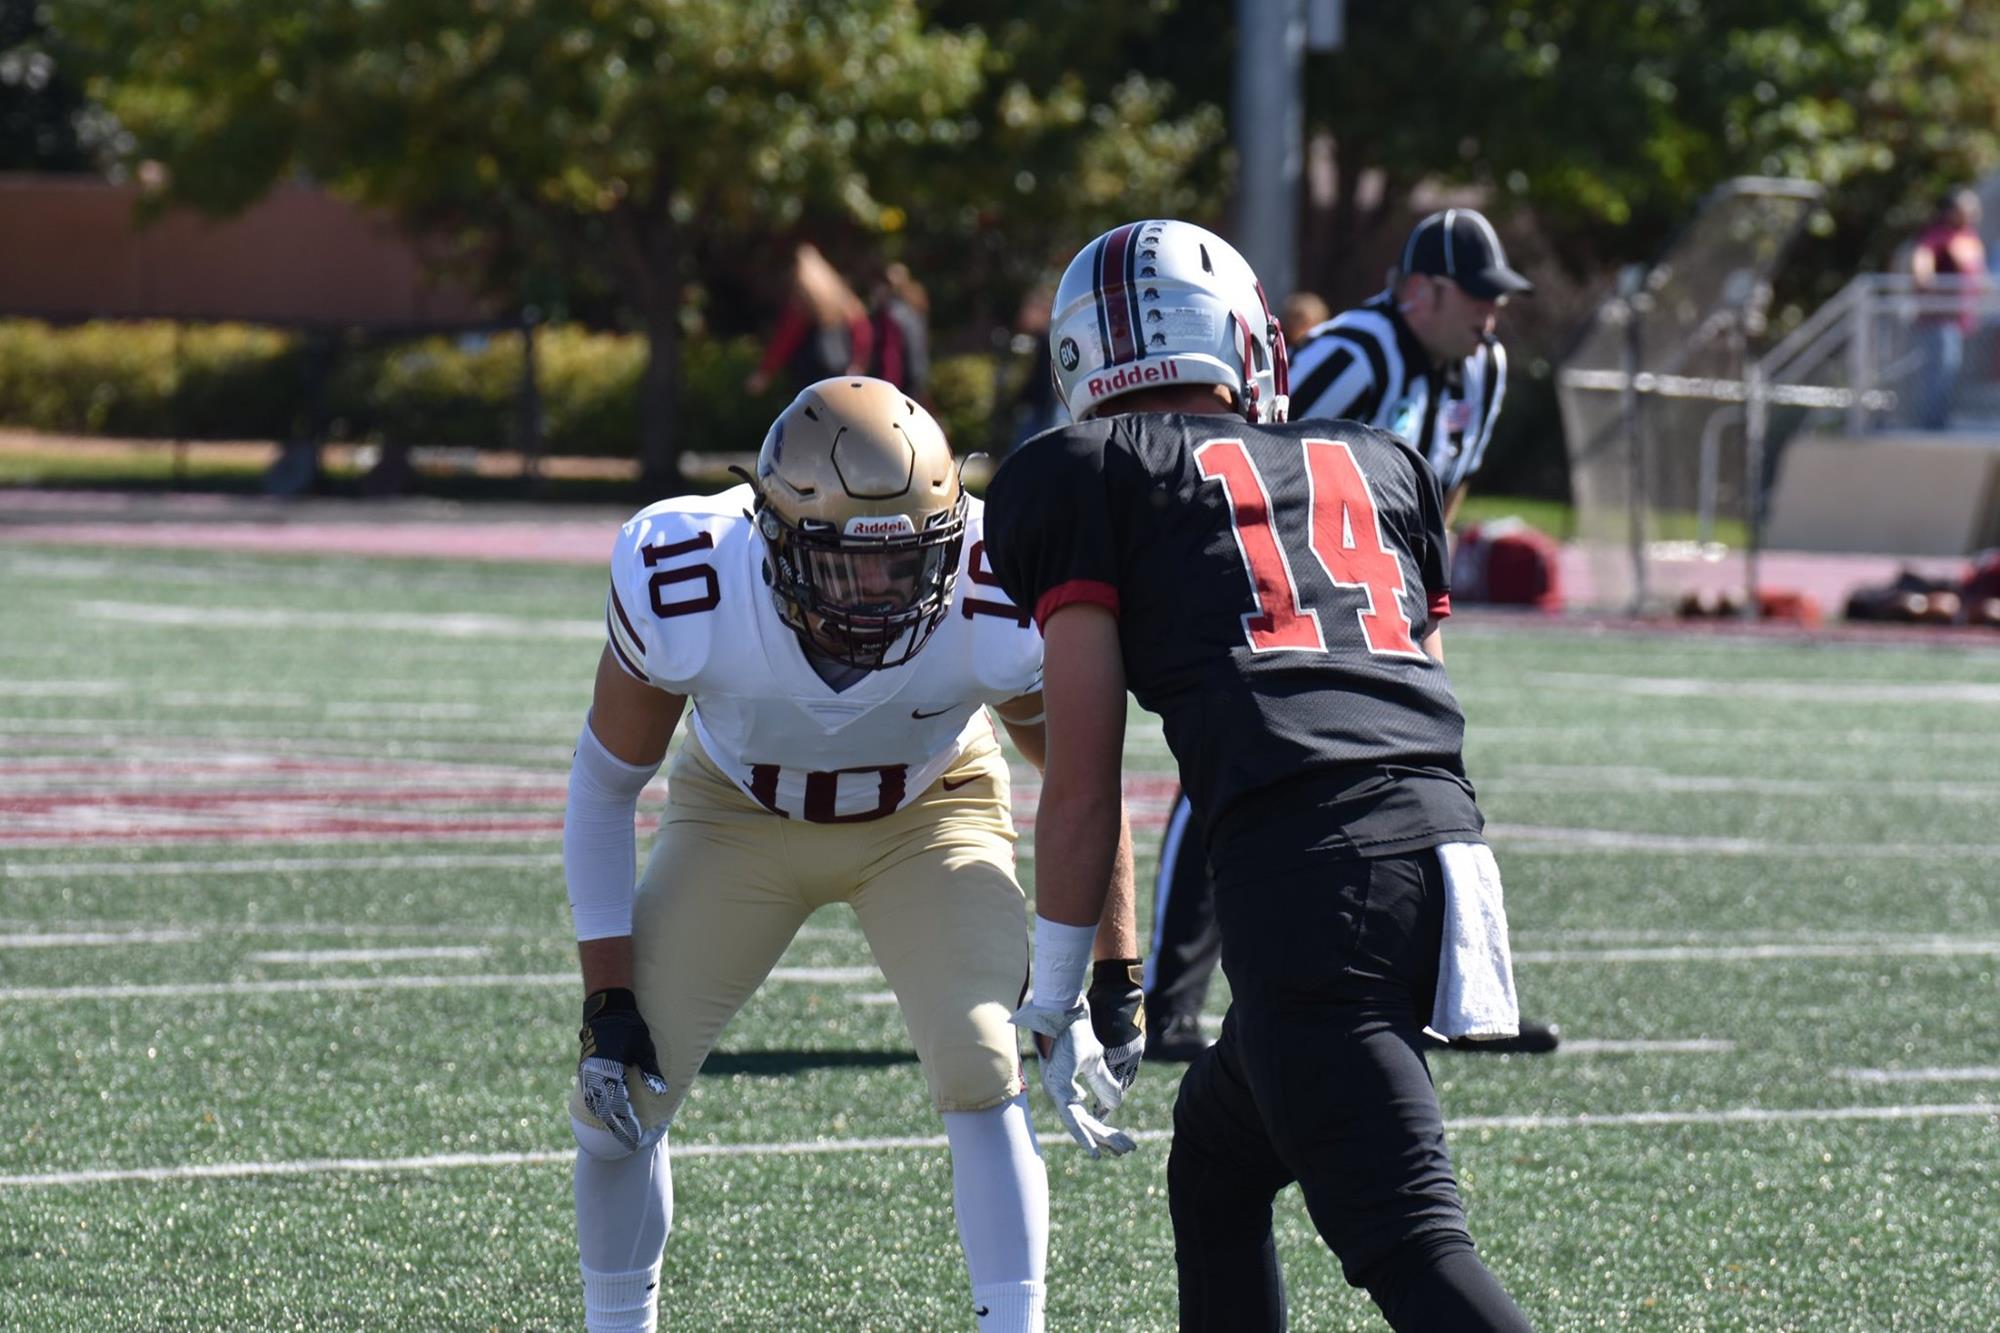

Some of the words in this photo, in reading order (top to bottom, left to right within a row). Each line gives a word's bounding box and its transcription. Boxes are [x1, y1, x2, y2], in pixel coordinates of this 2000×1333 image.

[1088, 360, 1178, 397] Riddell
[853, 521, 907, 534] Riddell
[1194, 438, 1429, 660] 14
[641, 530, 721, 619] 10
